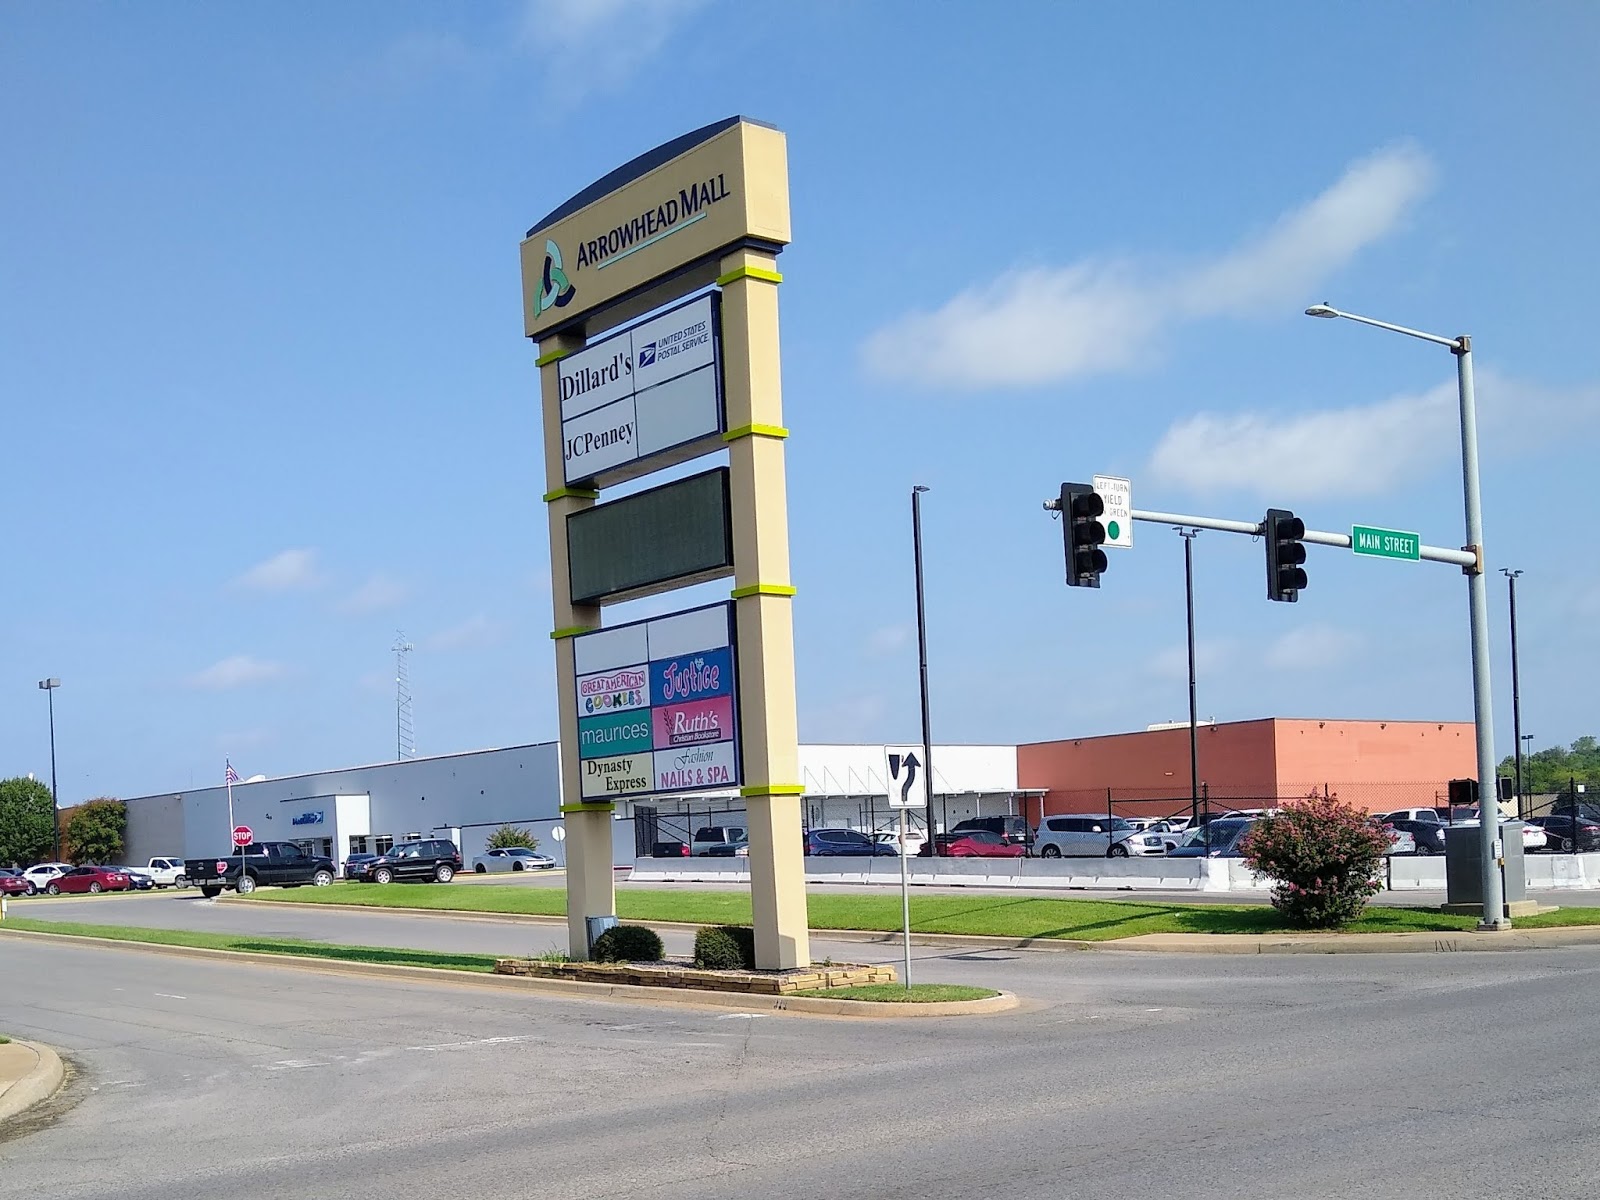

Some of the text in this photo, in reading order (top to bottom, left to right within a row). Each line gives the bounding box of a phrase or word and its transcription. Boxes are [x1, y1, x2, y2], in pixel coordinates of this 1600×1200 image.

[576, 173, 731, 271] ARROWHEAD MALL
[658, 320, 706, 348] UNITED STATES
[657, 332, 709, 361] POSTAL SERVICE
[561, 352, 632, 401] Dillard's
[565, 421, 634, 461] JCPenney
[1103, 494, 1123, 505] YIELD
[1359, 533, 1414, 554] MAIN STREET
[582, 674, 644, 694] GREAT AMERICAN
[663, 661, 720, 700] Justice
[585, 689, 643, 714] COOKIES
[582, 722, 649, 744] maurices
[673, 710, 718, 735] Ruth's
[673, 730, 719, 743] Christian Bookstore
[587, 758, 633, 777] Dynasty
[674, 747, 714, 771] Fashion
[606, 777, 647, 793] Express
[661, 765, 729, 789] NAILS & SPA
[233, 832, 252, 841] STOP
